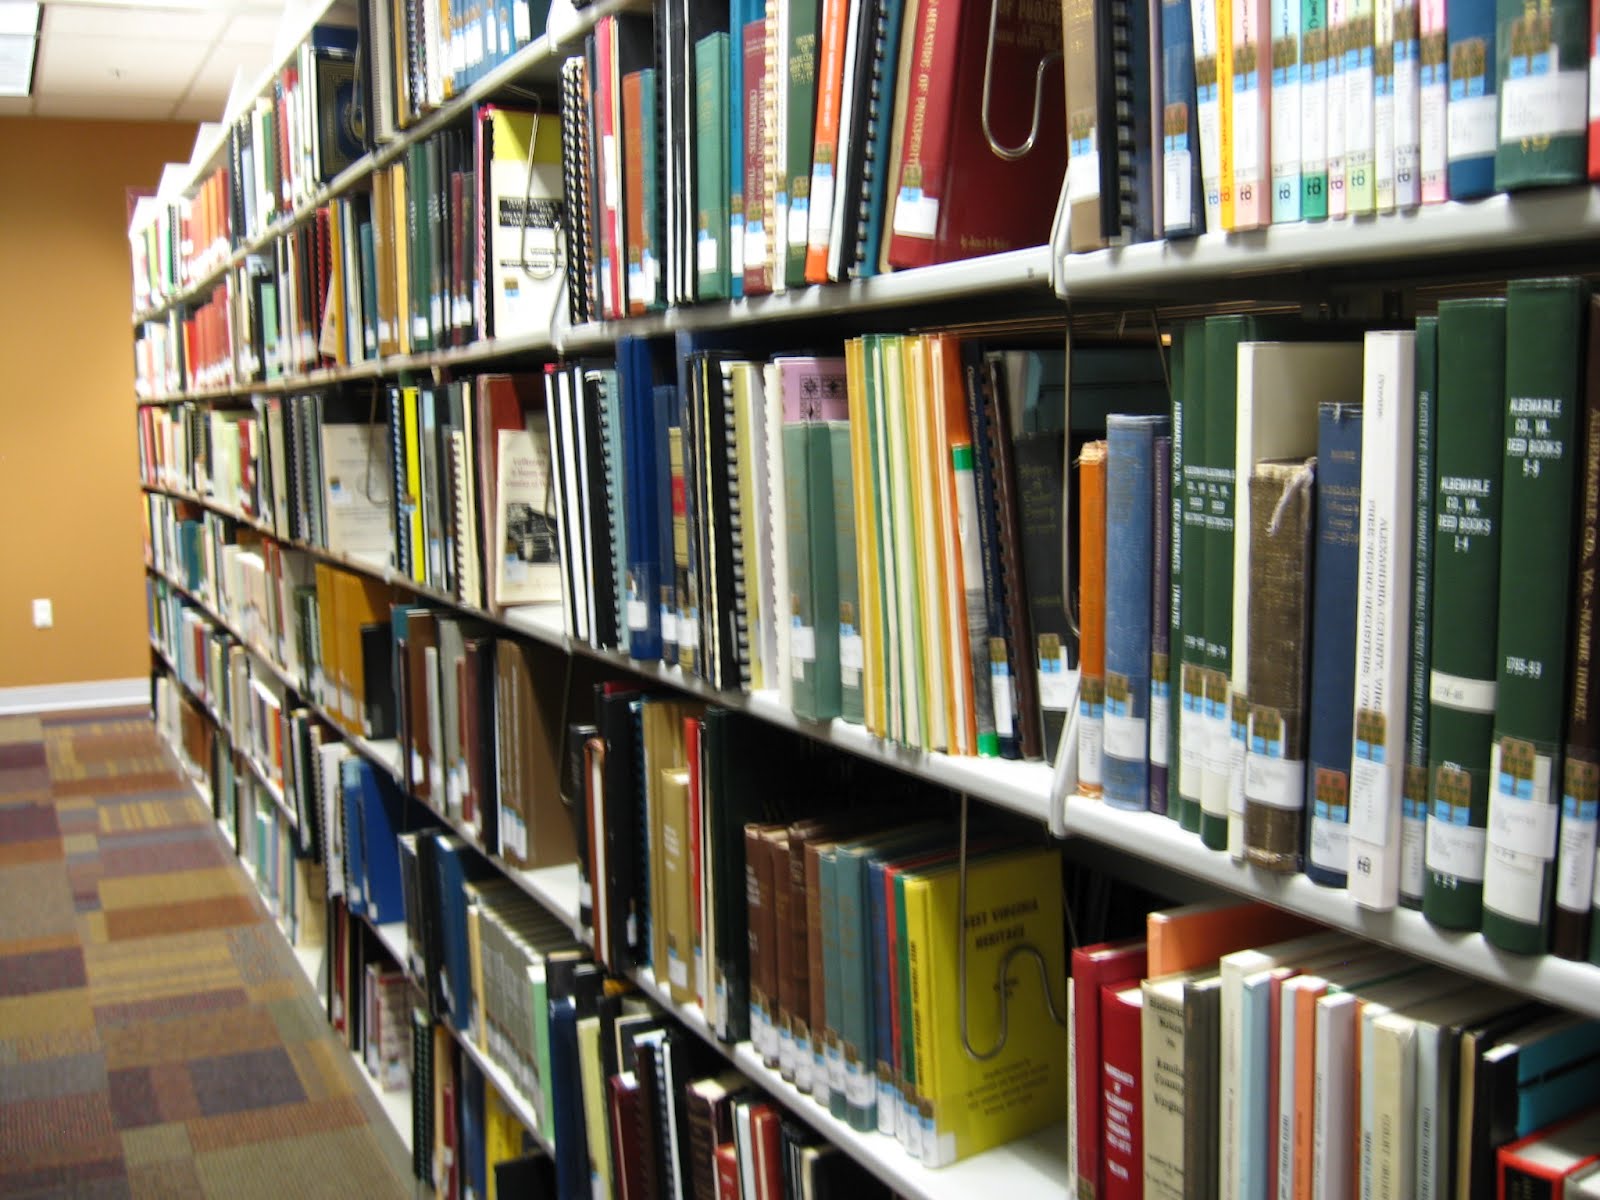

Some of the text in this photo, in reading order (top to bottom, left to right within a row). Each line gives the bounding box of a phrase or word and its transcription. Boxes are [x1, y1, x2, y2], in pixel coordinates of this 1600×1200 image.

[1509, 397, 1562, 417] ALBEMARLE
[1506, 437, 1563, 458] DEED BOOKS
[1440, 476, 1491, 497] ALBEMARLE
[1437, 513, 1492, 536] DEED BOOKS
[1376, 518, 1389, 607] ALEXANDRIA
[1574, 667, 1588, 720] INDEX
